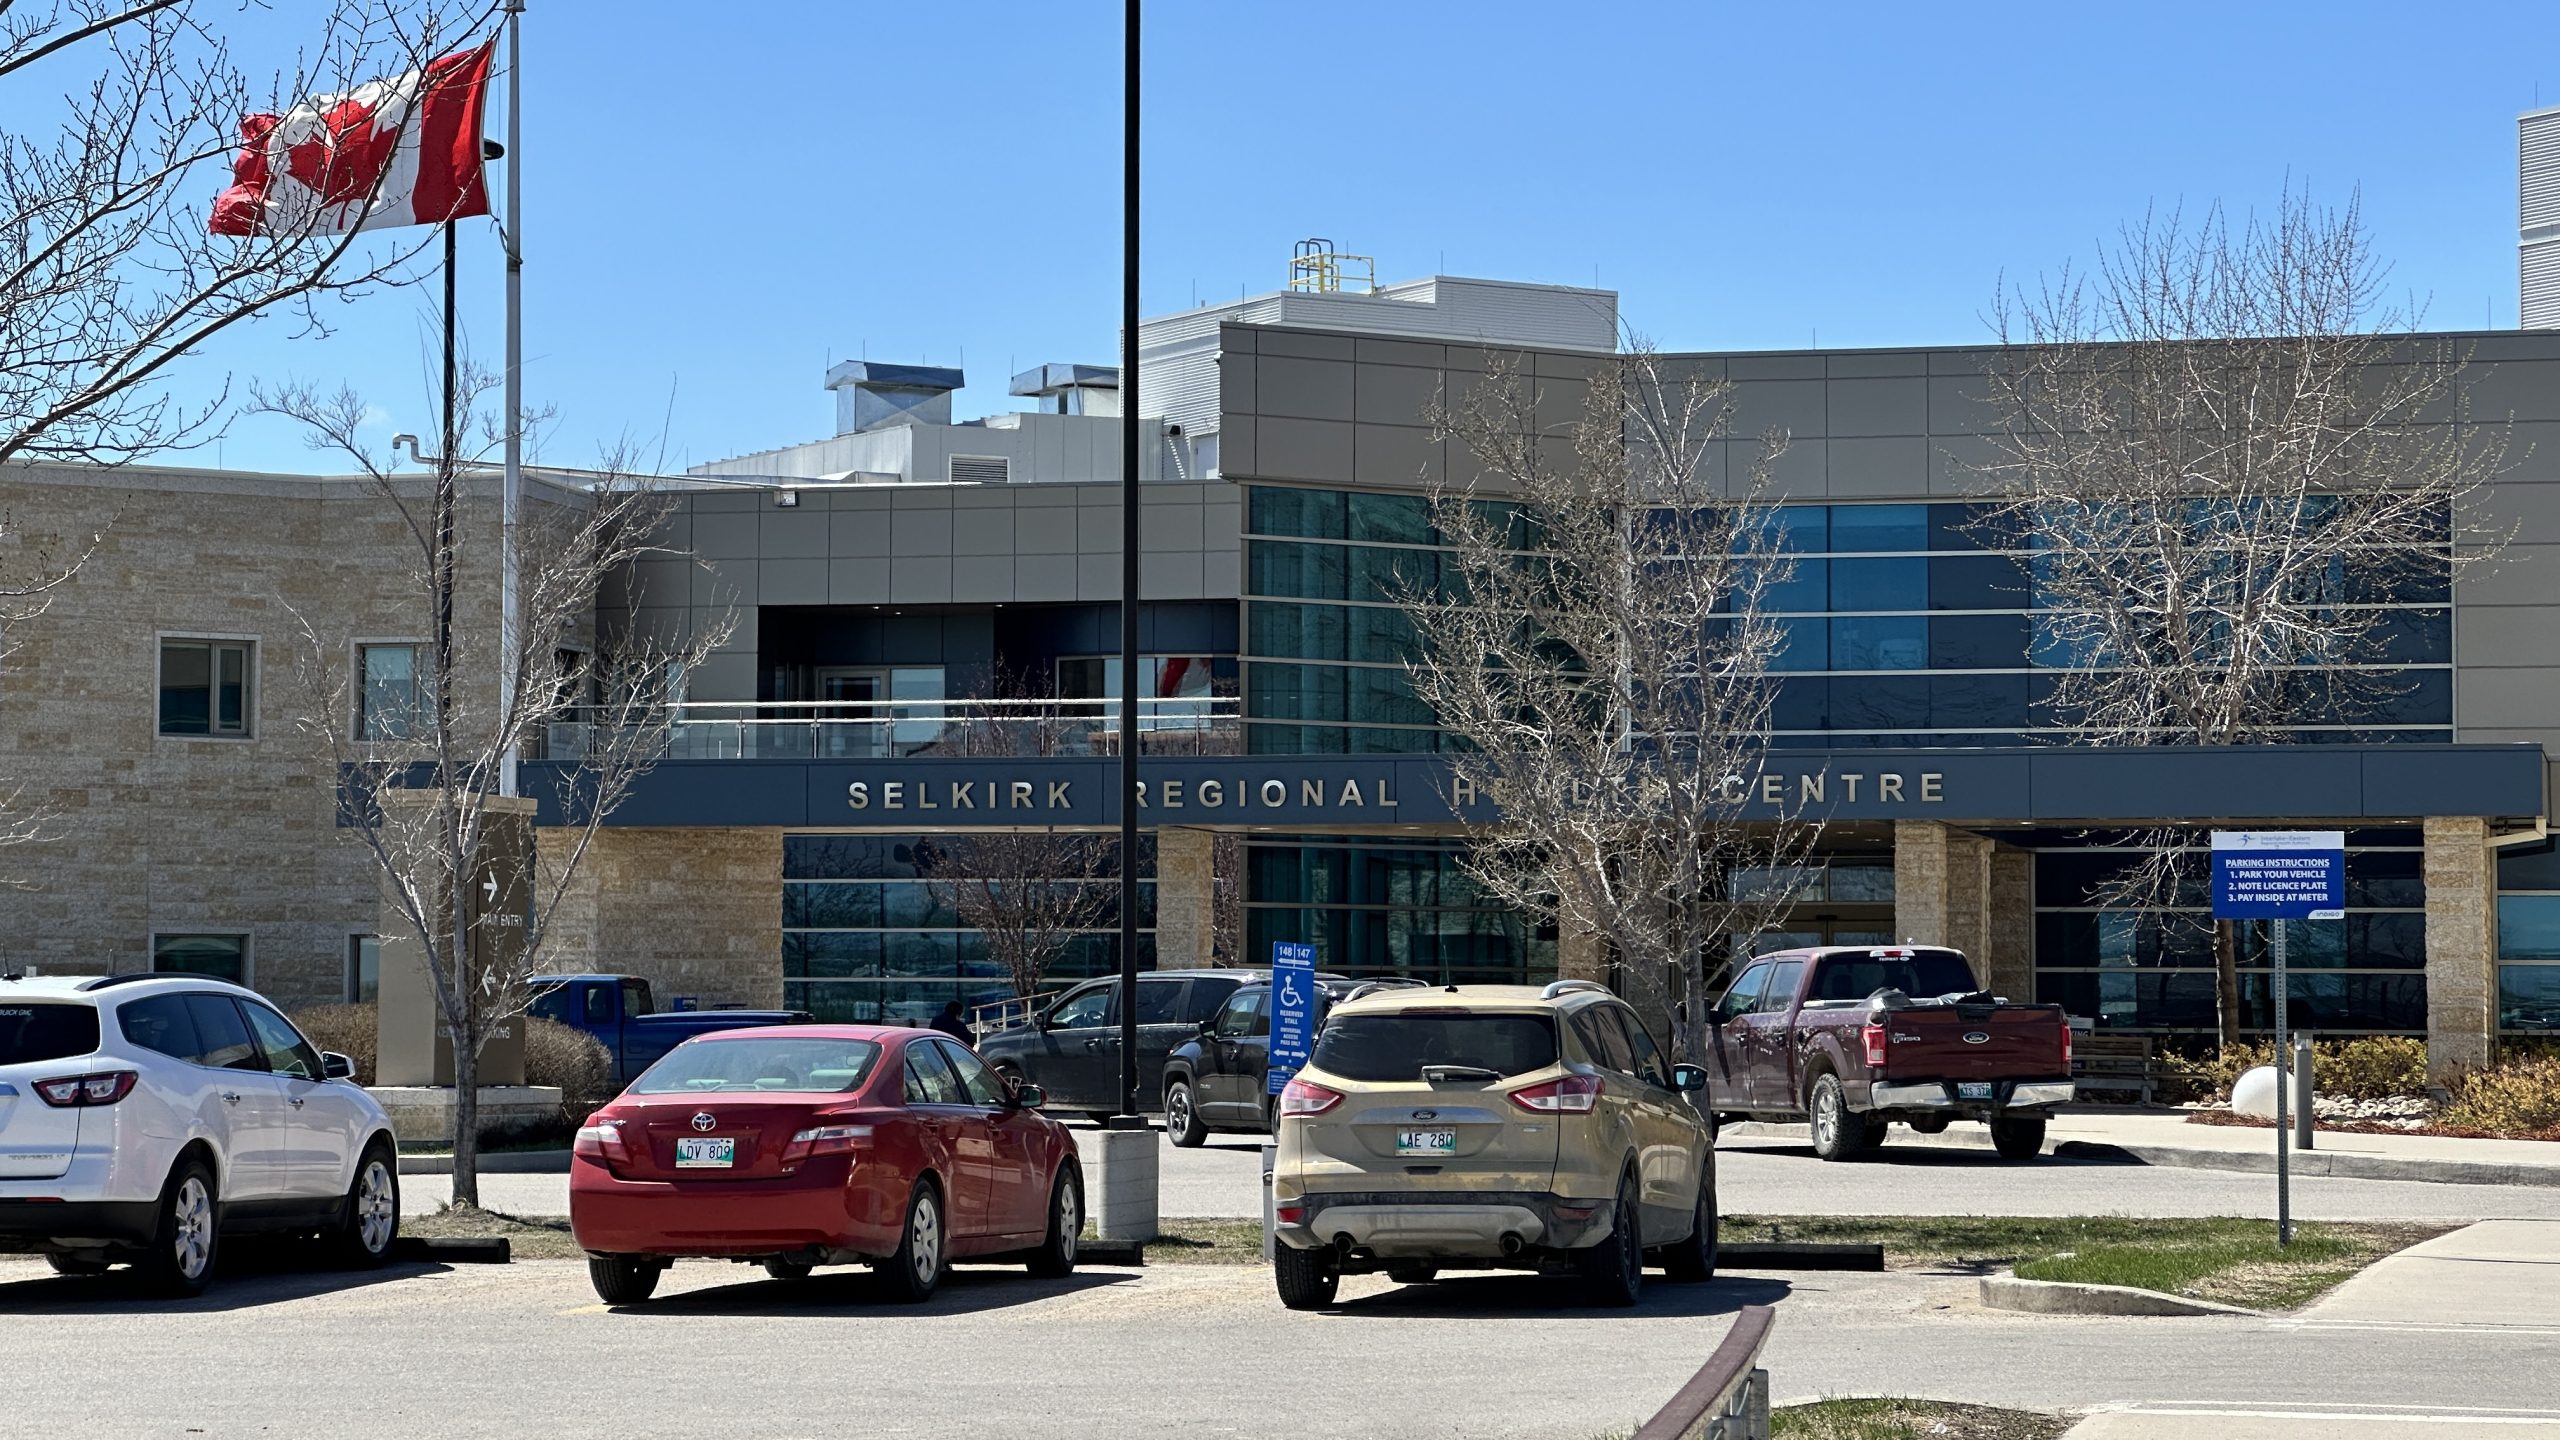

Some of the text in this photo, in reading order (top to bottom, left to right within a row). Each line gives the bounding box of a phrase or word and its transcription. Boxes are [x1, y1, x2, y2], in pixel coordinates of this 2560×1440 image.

[848, 781, 1073, 810] SELKIRK
[1453, 777, 1667, 806] HLTH
[1724, 773, 1945, 804] CENTRE
[2225, 859, 2330, 867] PARKING INSTRUCTIONS
[2230, 870, 2326, 879] 1. PARK YOUR VEHICLE
[2228, 882, 2327, 890] 2. NOTE LICENCE PLATE
[2228, 893, 2328, 902] 3. PAY INSIDE AT METER
[500, 914, 523, 927] ENTRY
[1279, 946, 1311, 958] 148 147
[1398, 1133, 1453, 1148] LAE 280
[679, 1145, 731, 1159] LDV 809
